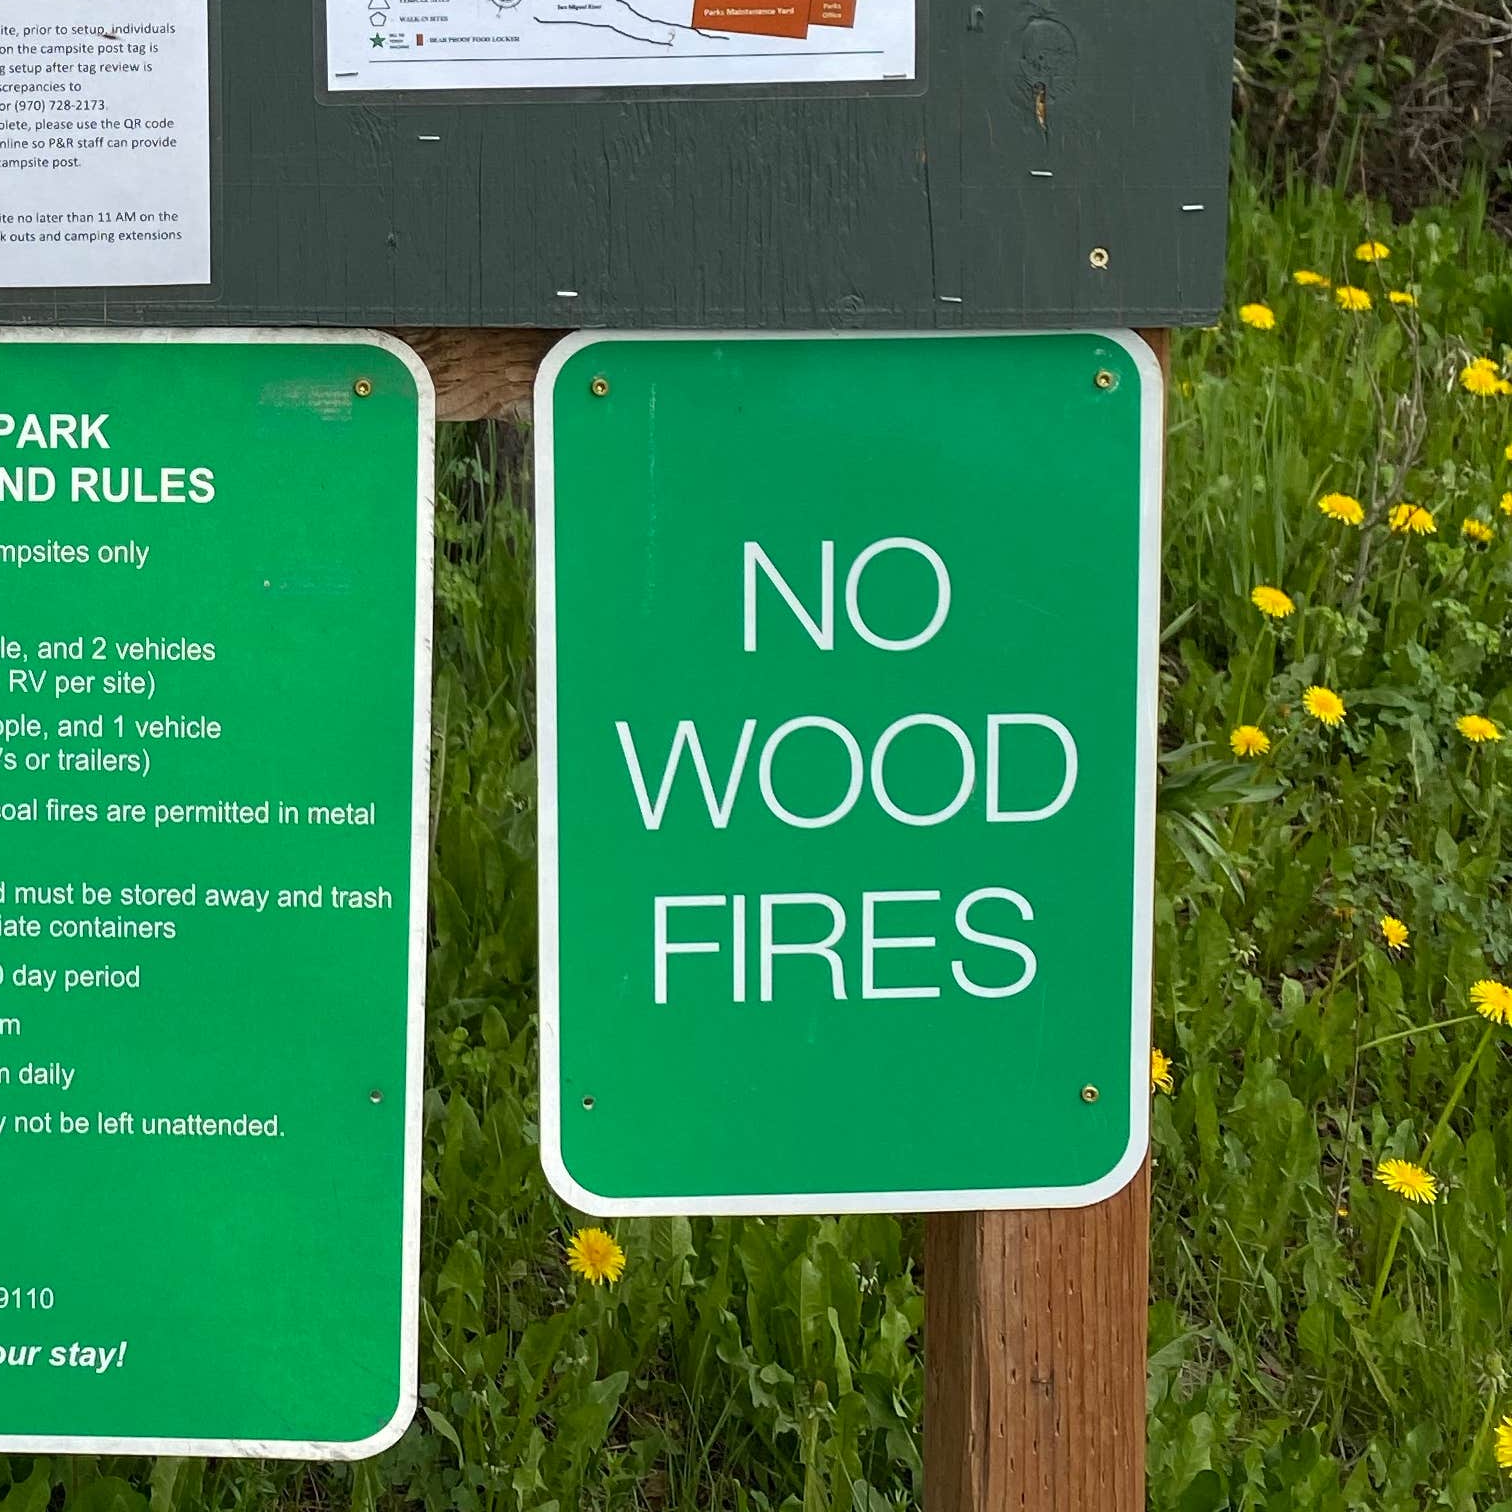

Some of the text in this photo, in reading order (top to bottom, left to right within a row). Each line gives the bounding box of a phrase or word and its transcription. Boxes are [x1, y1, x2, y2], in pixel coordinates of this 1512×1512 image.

[14, 99, 46, 113] (970)
[72, 468, 214, 503] RULES
[97, 539, 150, 570] only
[744, 537, 950, 651] NO
[37, 636, 83, 660] and
[91, 636, 107, 660] 2
[115, 637, 216, 661] vehicles
[9, 669, 47, 693] RV
[55, 675, 96, 699] per
[103, 670, 155, 700] site)
[57, 714, 103, 738] and
[113, 714, 123, 738] 1
[135, 715, 222, 739] vehicle
[25, 752, 51, 771] or
[57, 747, 151, 777] trailers)
[616, 714, 1078, 830] WOOD
[655, 888, 1036, 1004] FIRES
[49, 1342, 127, 1373] stay!
